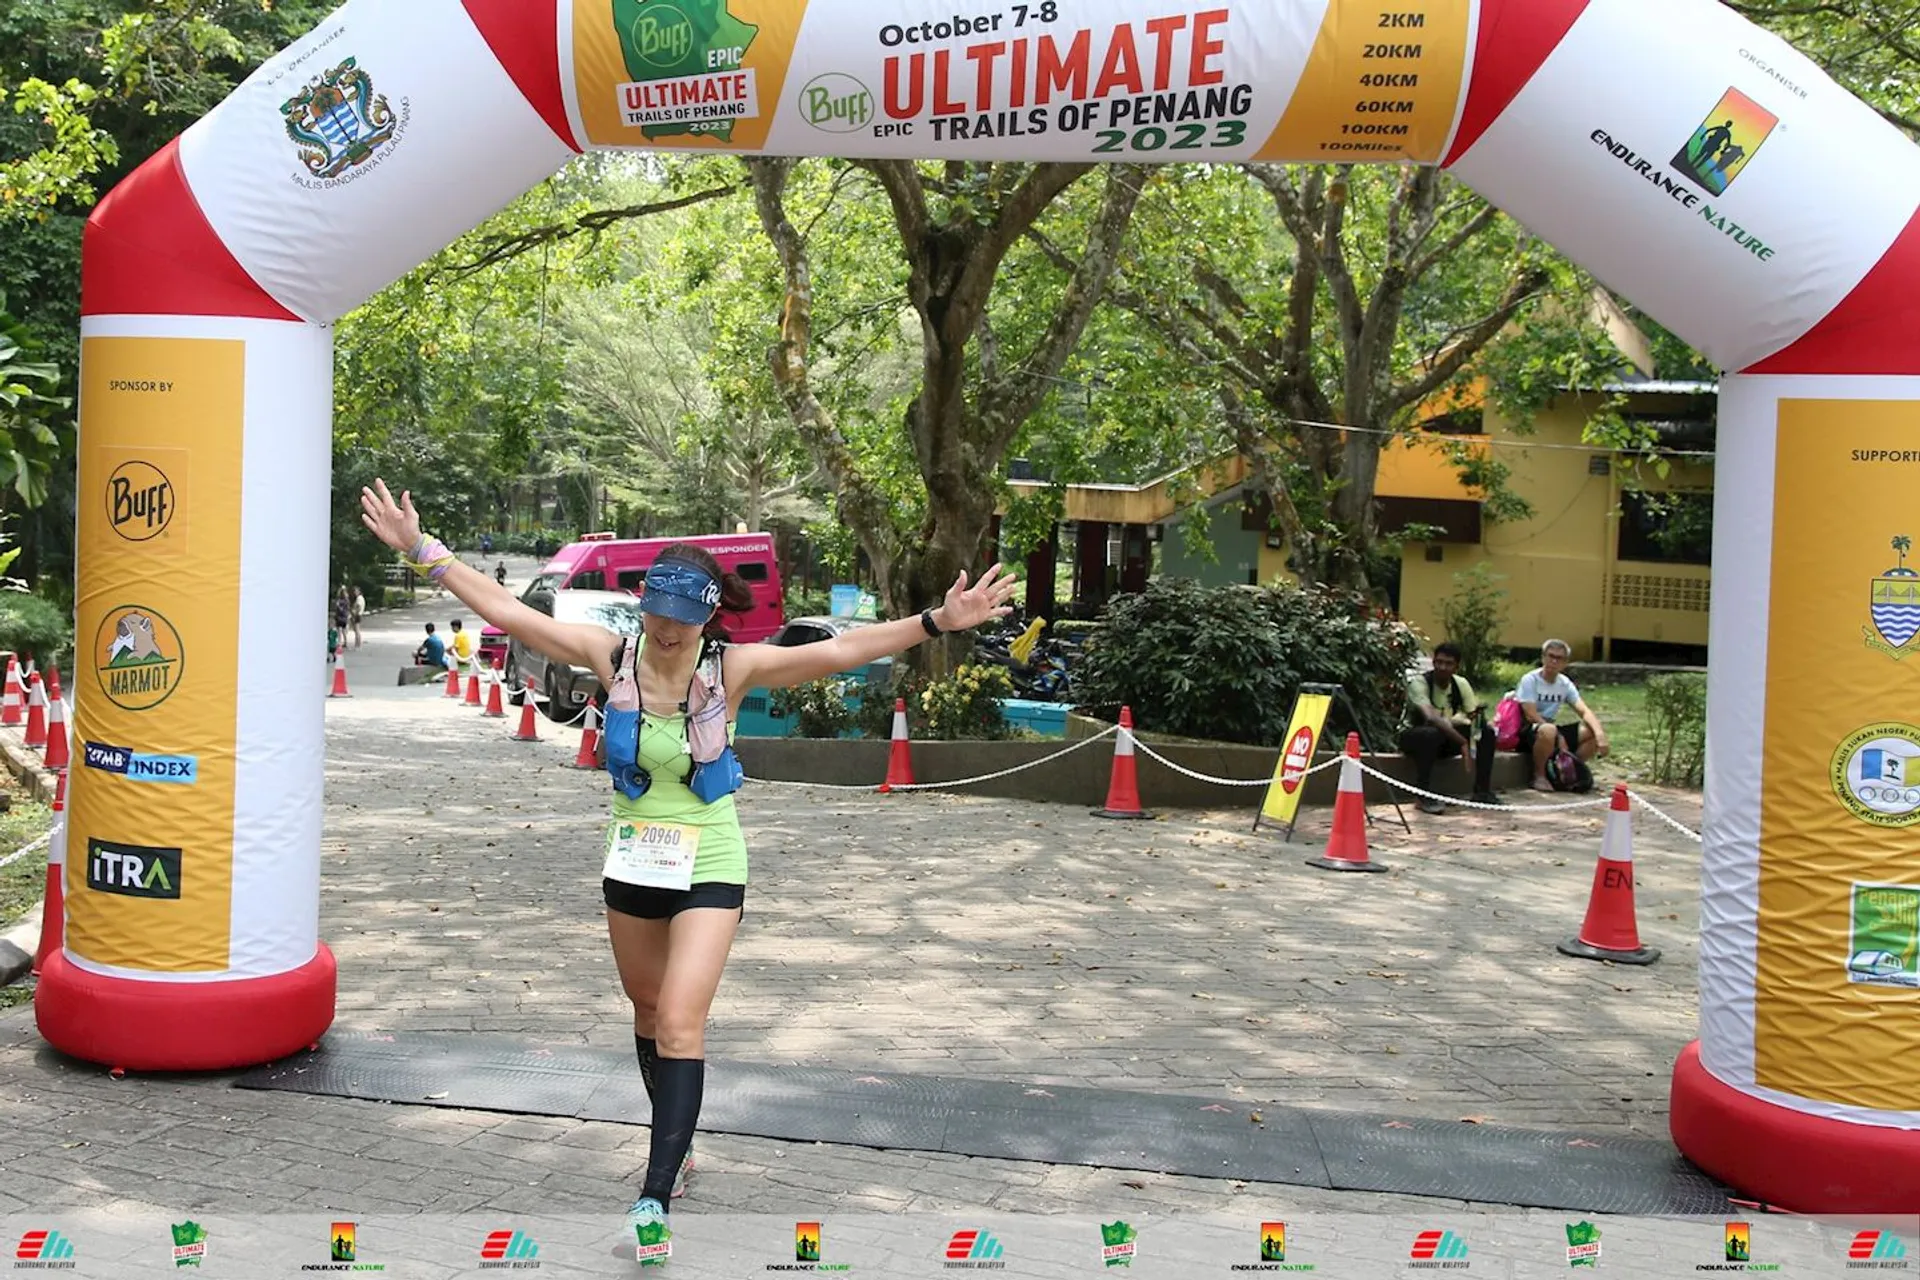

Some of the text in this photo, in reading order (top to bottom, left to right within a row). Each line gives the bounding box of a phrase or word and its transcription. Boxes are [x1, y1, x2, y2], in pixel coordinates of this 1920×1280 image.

[879, 0, 1058, 47] October 7-8
[1378, 13, 1424, 28] 2KM
[639, 16, 688, 57] Buff
[288, 26, 346, 71] ORGANISER
[707, 46, 743, 68] EPIC
[1363, 44, 1421, 58] 20KM
[883, 9, 1228, 121] ULTIMATE
[1738, 48, 1808, 100] ORGANISER
[1359, 74, 1418, 87] 40KM
[626, 74, 747, 110] ULTIMATE
[628, 102, 746, 123] TRAILS OF PENANG
[807, 86, 868, 125] Buff
[874, 84, 1253, 141] EPIC TRAILS OF PENANG
[1355, 101, 1414, 113] 60KM
[689, 121, 731, 132] 2023
[1091, 120, 1247, 153] 2023
[1341, 124, 1409, 135] 100KM
[290, 96, 410, 190] MAJLIS BANDARAYA PULAU PINANG
[1319, 142, 1404, 152] 100Miles
[1590, 129, 1776, 261] ENDURANCE NATURE
[110, 380, 174, 392] SPONSOR BY
[1851, 449, 1920, 462] SUPPORT
[112, 477, 168, 528] Buff
[110, 665, 170, 696] MARMOT
[1292, 735, 1310, 756] NO
[134, 761, 191, 776] INDEX
[641, 826, 682, 845] 20960
[1603, 868, 1632, 890] EN
